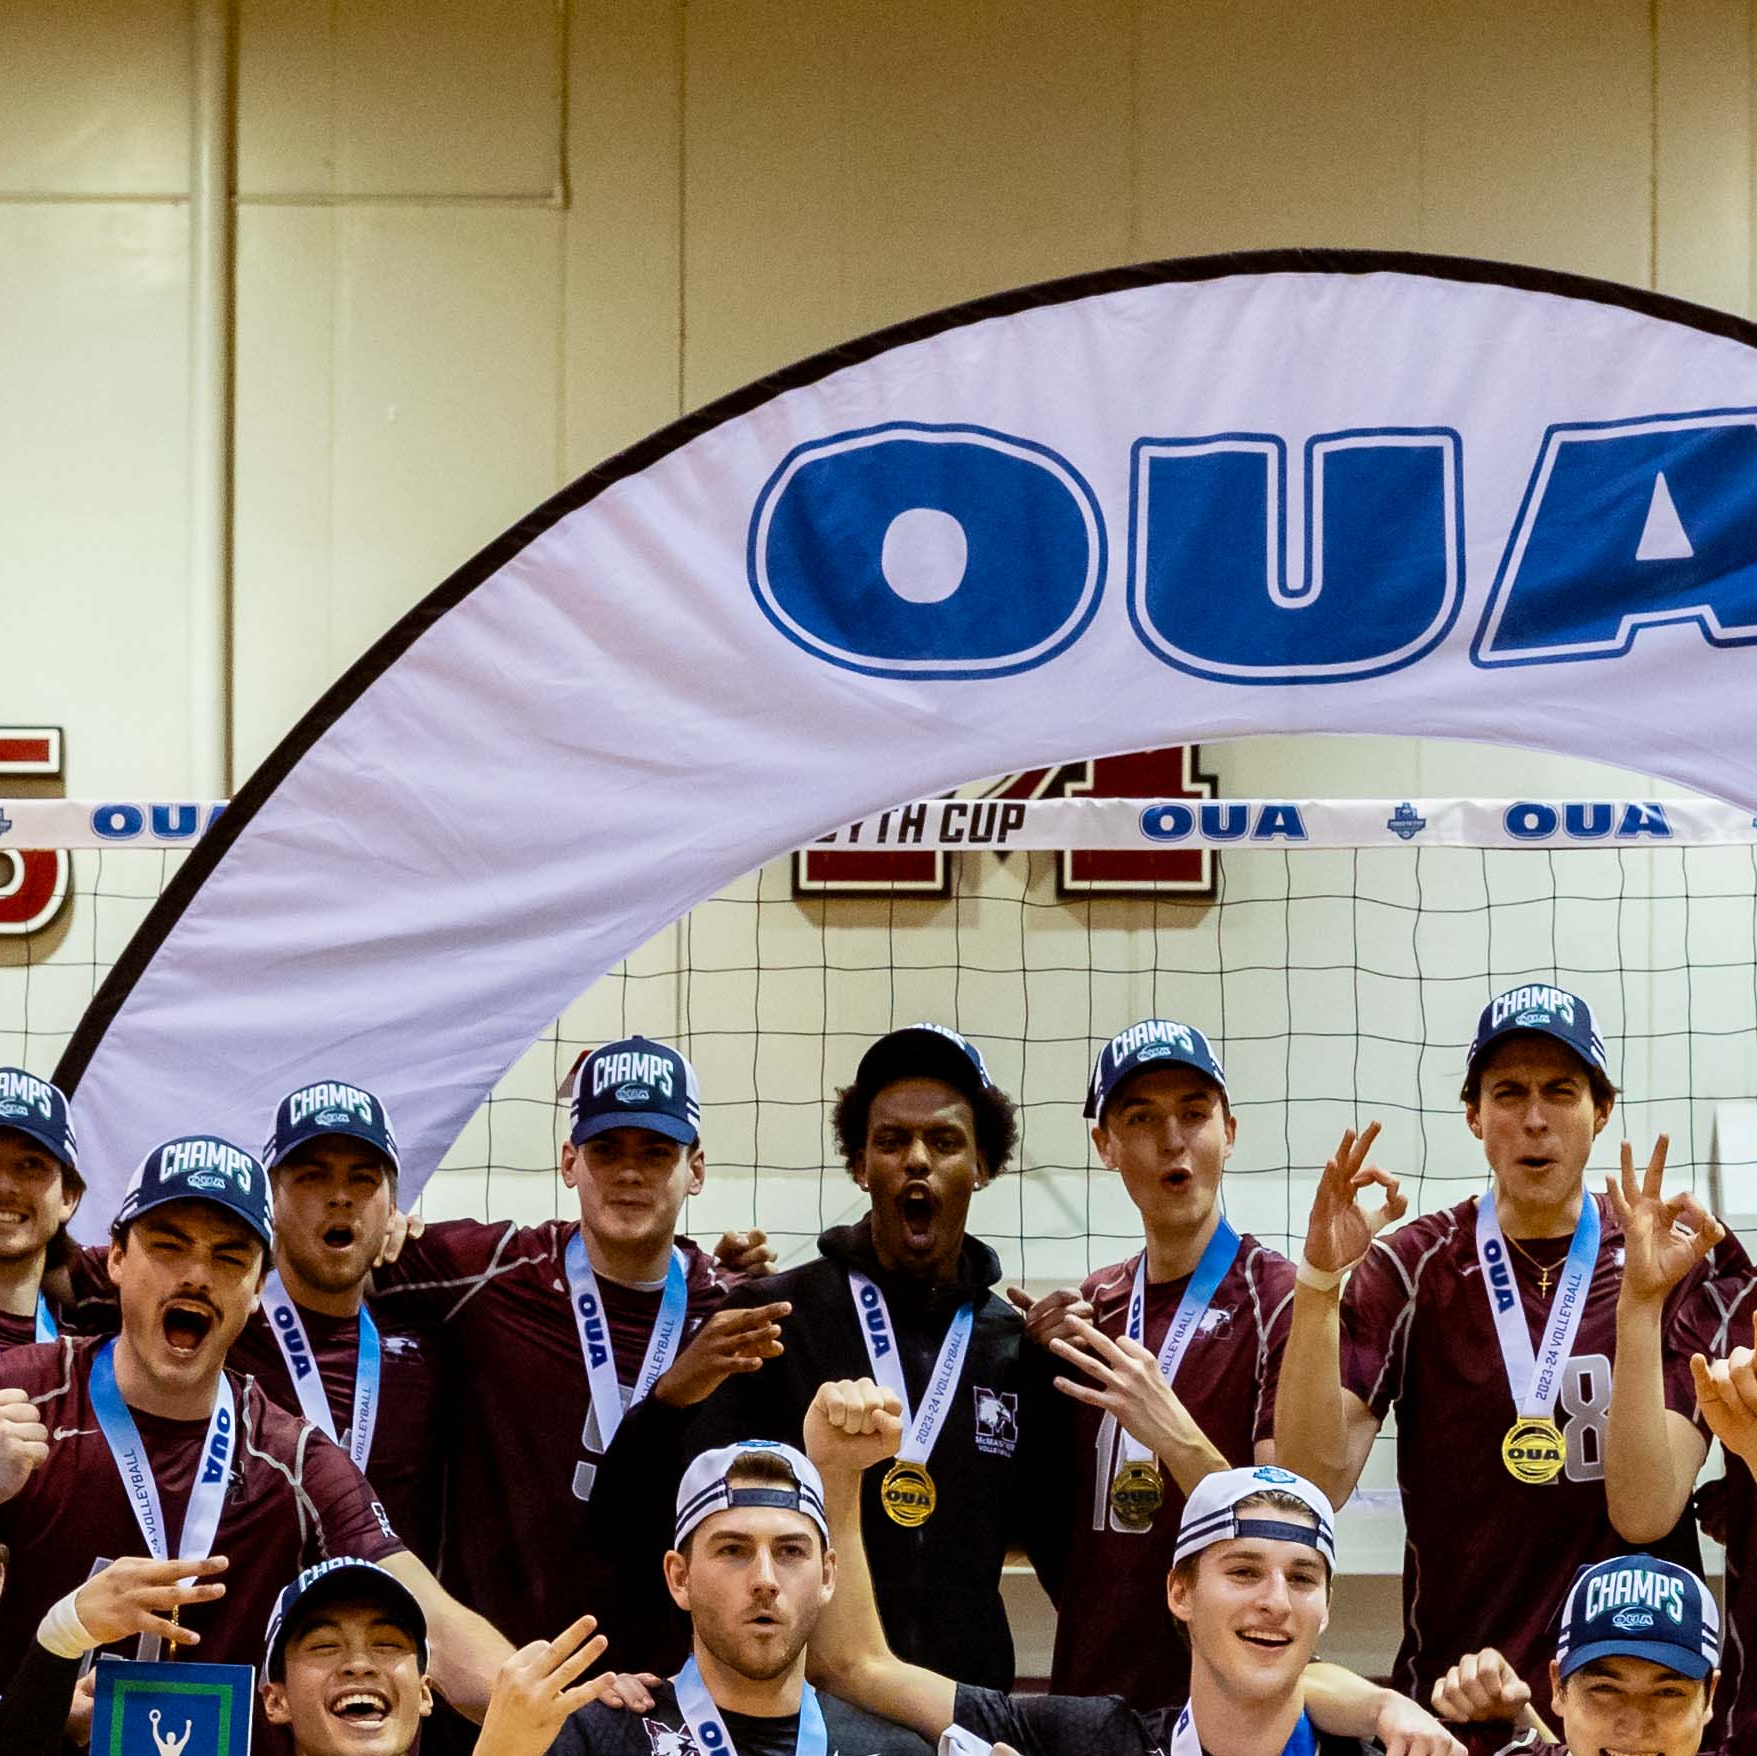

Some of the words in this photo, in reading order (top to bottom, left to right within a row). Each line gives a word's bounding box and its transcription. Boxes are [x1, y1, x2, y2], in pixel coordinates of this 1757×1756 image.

[90, 801, 230, 840] OU
[938, 802, 1026, 845] CUP
[1139, 801, 1309, 842] OUA
[1502, 801, 1673, 840] OUA
[1490, 986, 1576, 1030] CHAMPS
[1111, 1018, 1195, 1068] CHAMPS
[289, 1085, 374, 1128] CHAMPS
[592, 1053, 675, 1098] CHAMPS
[159, 1138, 254, 1195] CHAMPS
[1482, 1238, 1515, 1315] OUA
[273, 1303, 313, 1381] OUA
[574, 1291, 607, 1371] OUA
[860, 1284, 890, 1360] OUA
[1160, 1307, 1197, 1377] OLLEYBALL
[1535, 1348, 1561, 1401] 2023-24
[1550, 1270, 1583, 1350] VOLLEYBALL
[915, 1397, 942, 1446] 2023-24
[933, 1329, 965, 1401] VOLLEYBALL
[1559, 1352, 1612, 1483] 8
[201, 1406, 234, 1485] OUA
[354, 1385, 373, 1463] VOLLEYBALL
[1507, 1445, 1561, 1463] OUA
[125, 1447, 157, 1541] VOLLEYBALL
[1584, 1569, 1685, 1625] CHAMPS
